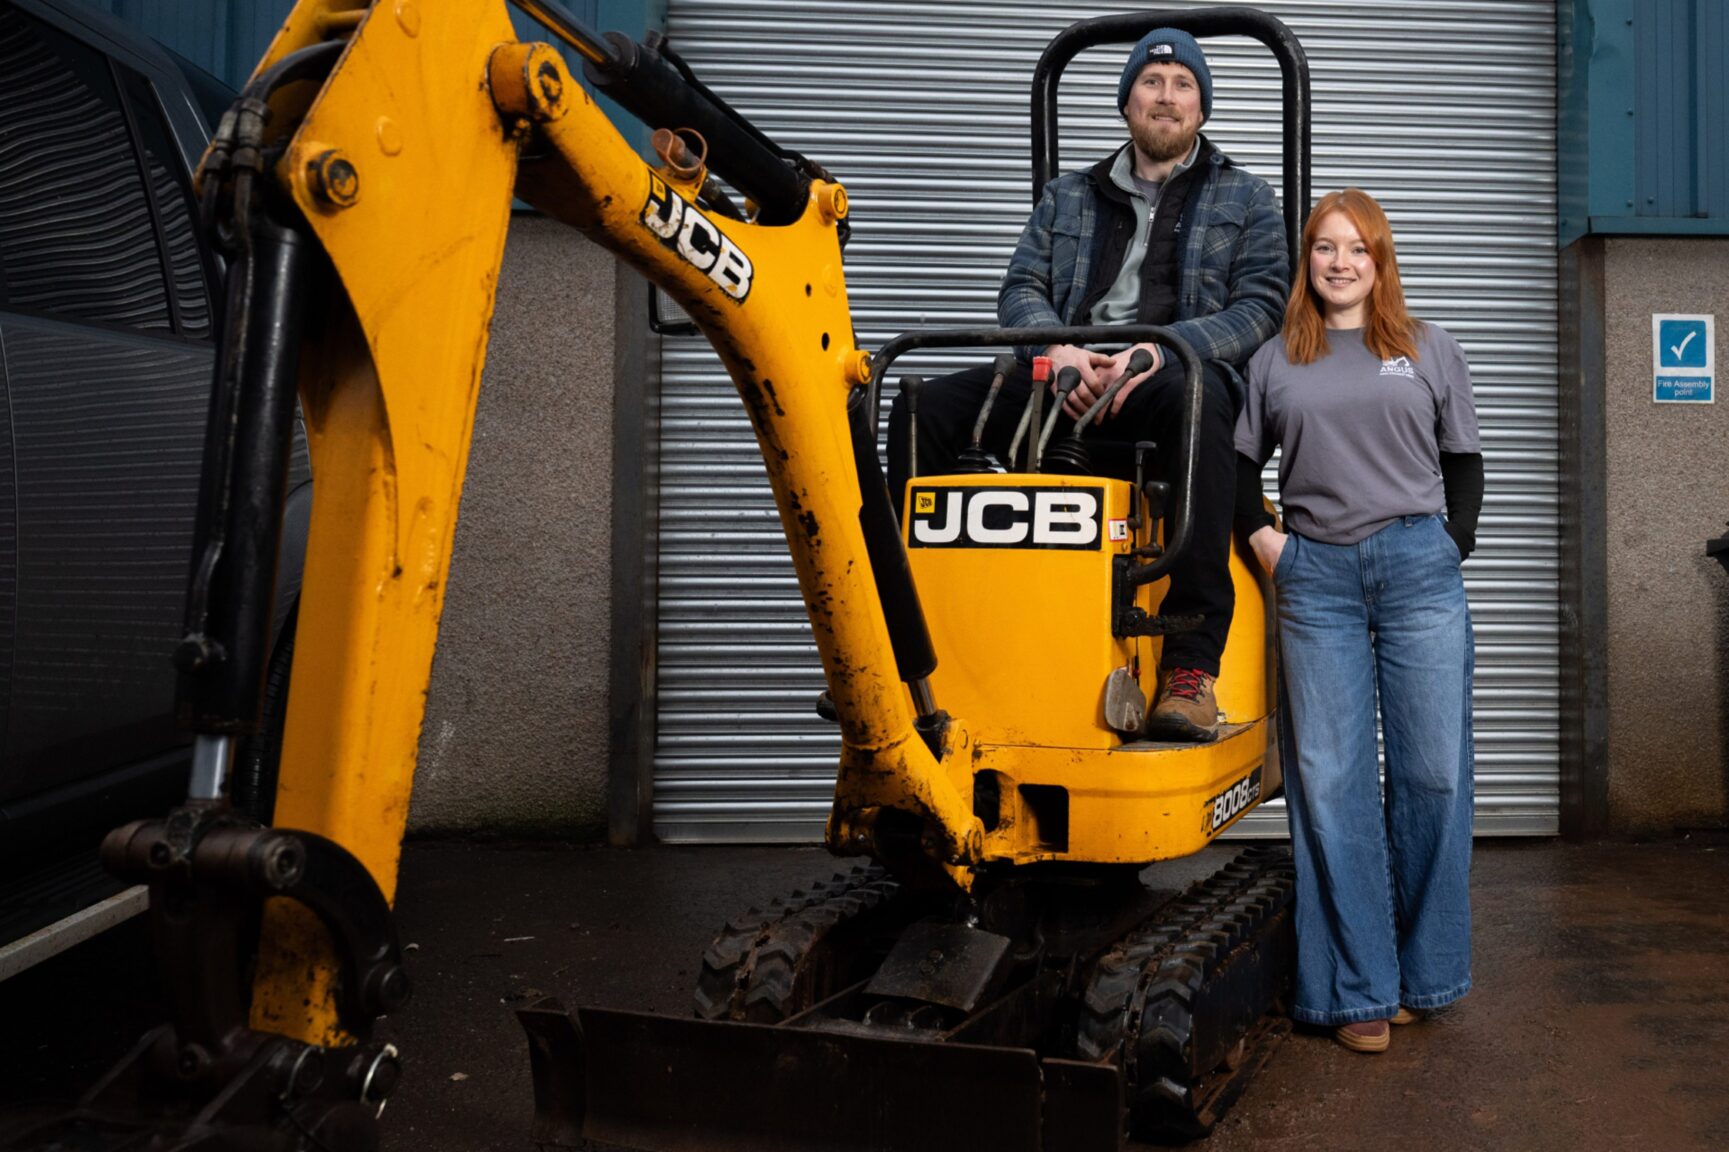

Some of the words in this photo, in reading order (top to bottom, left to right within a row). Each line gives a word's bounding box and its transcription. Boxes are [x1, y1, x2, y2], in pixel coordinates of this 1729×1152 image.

[645, 191, 752, 299] JCB
[1380, 366, 1414, 374] ANGUS
[1657, 380, 1671, 388] Fire
[1674, 380, 1709, 390] Assembly
[1674, 388, 1692, 397] point
[914, 491, 1097, 544] JCB
